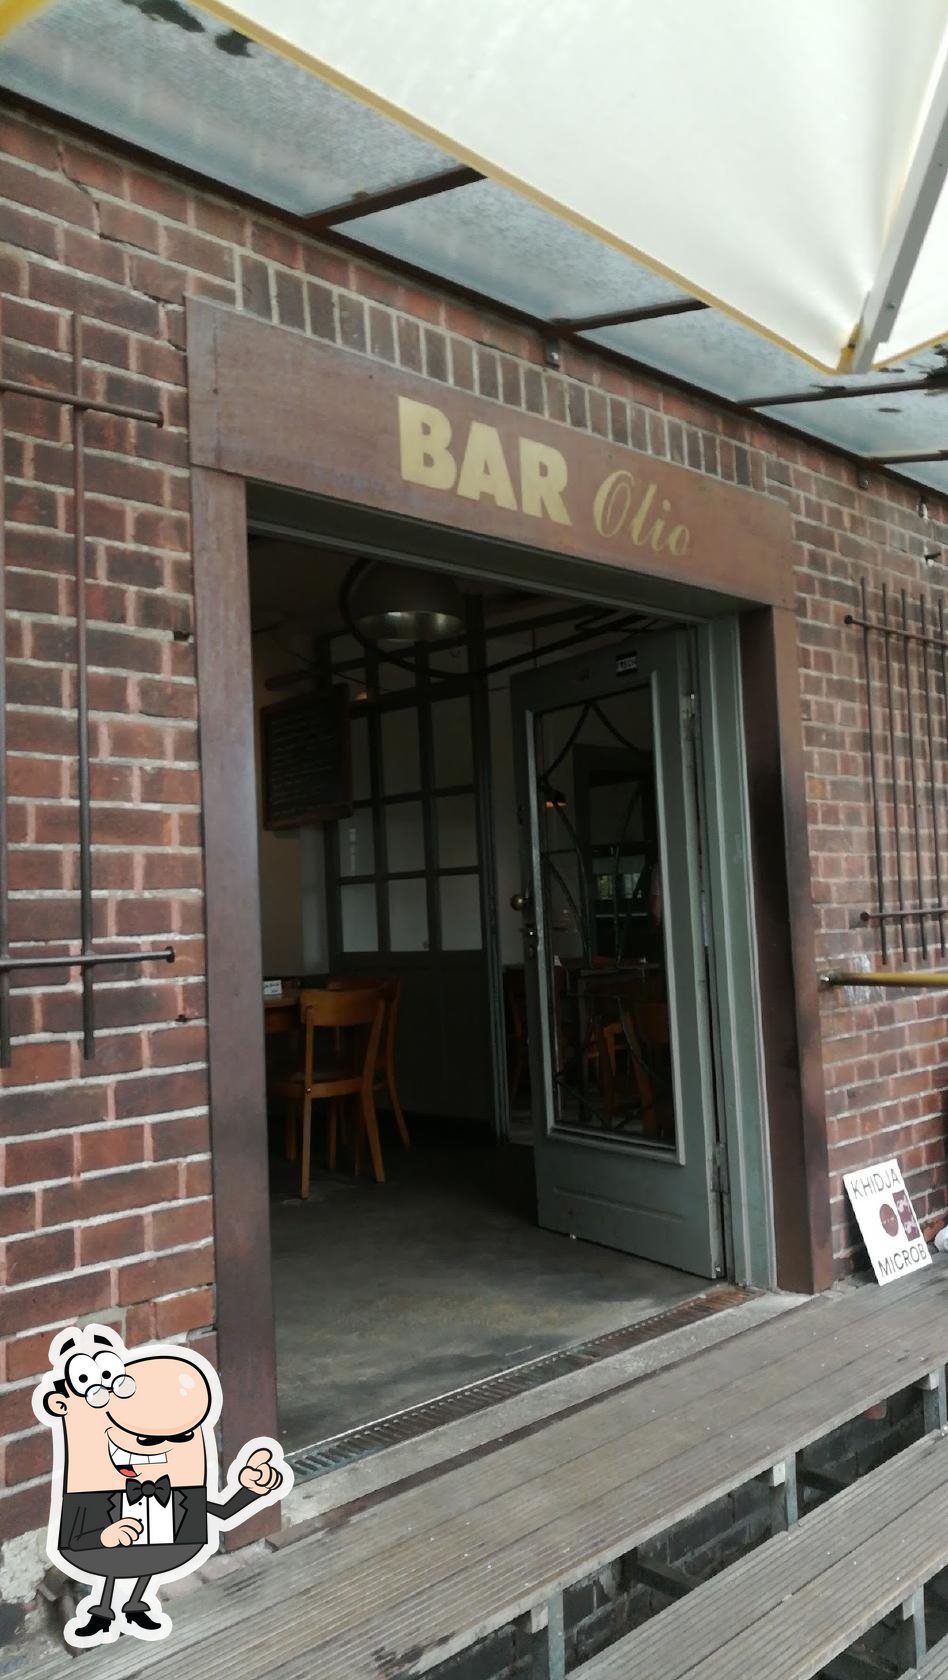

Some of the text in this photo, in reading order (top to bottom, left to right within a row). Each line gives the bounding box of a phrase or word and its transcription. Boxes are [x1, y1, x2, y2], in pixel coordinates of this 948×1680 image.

[398, 395, 690, 555] BAR Olio
[851, 1168, 901, 1199] KHIDJA
[877, 1243, 928, 1277] MICROB
